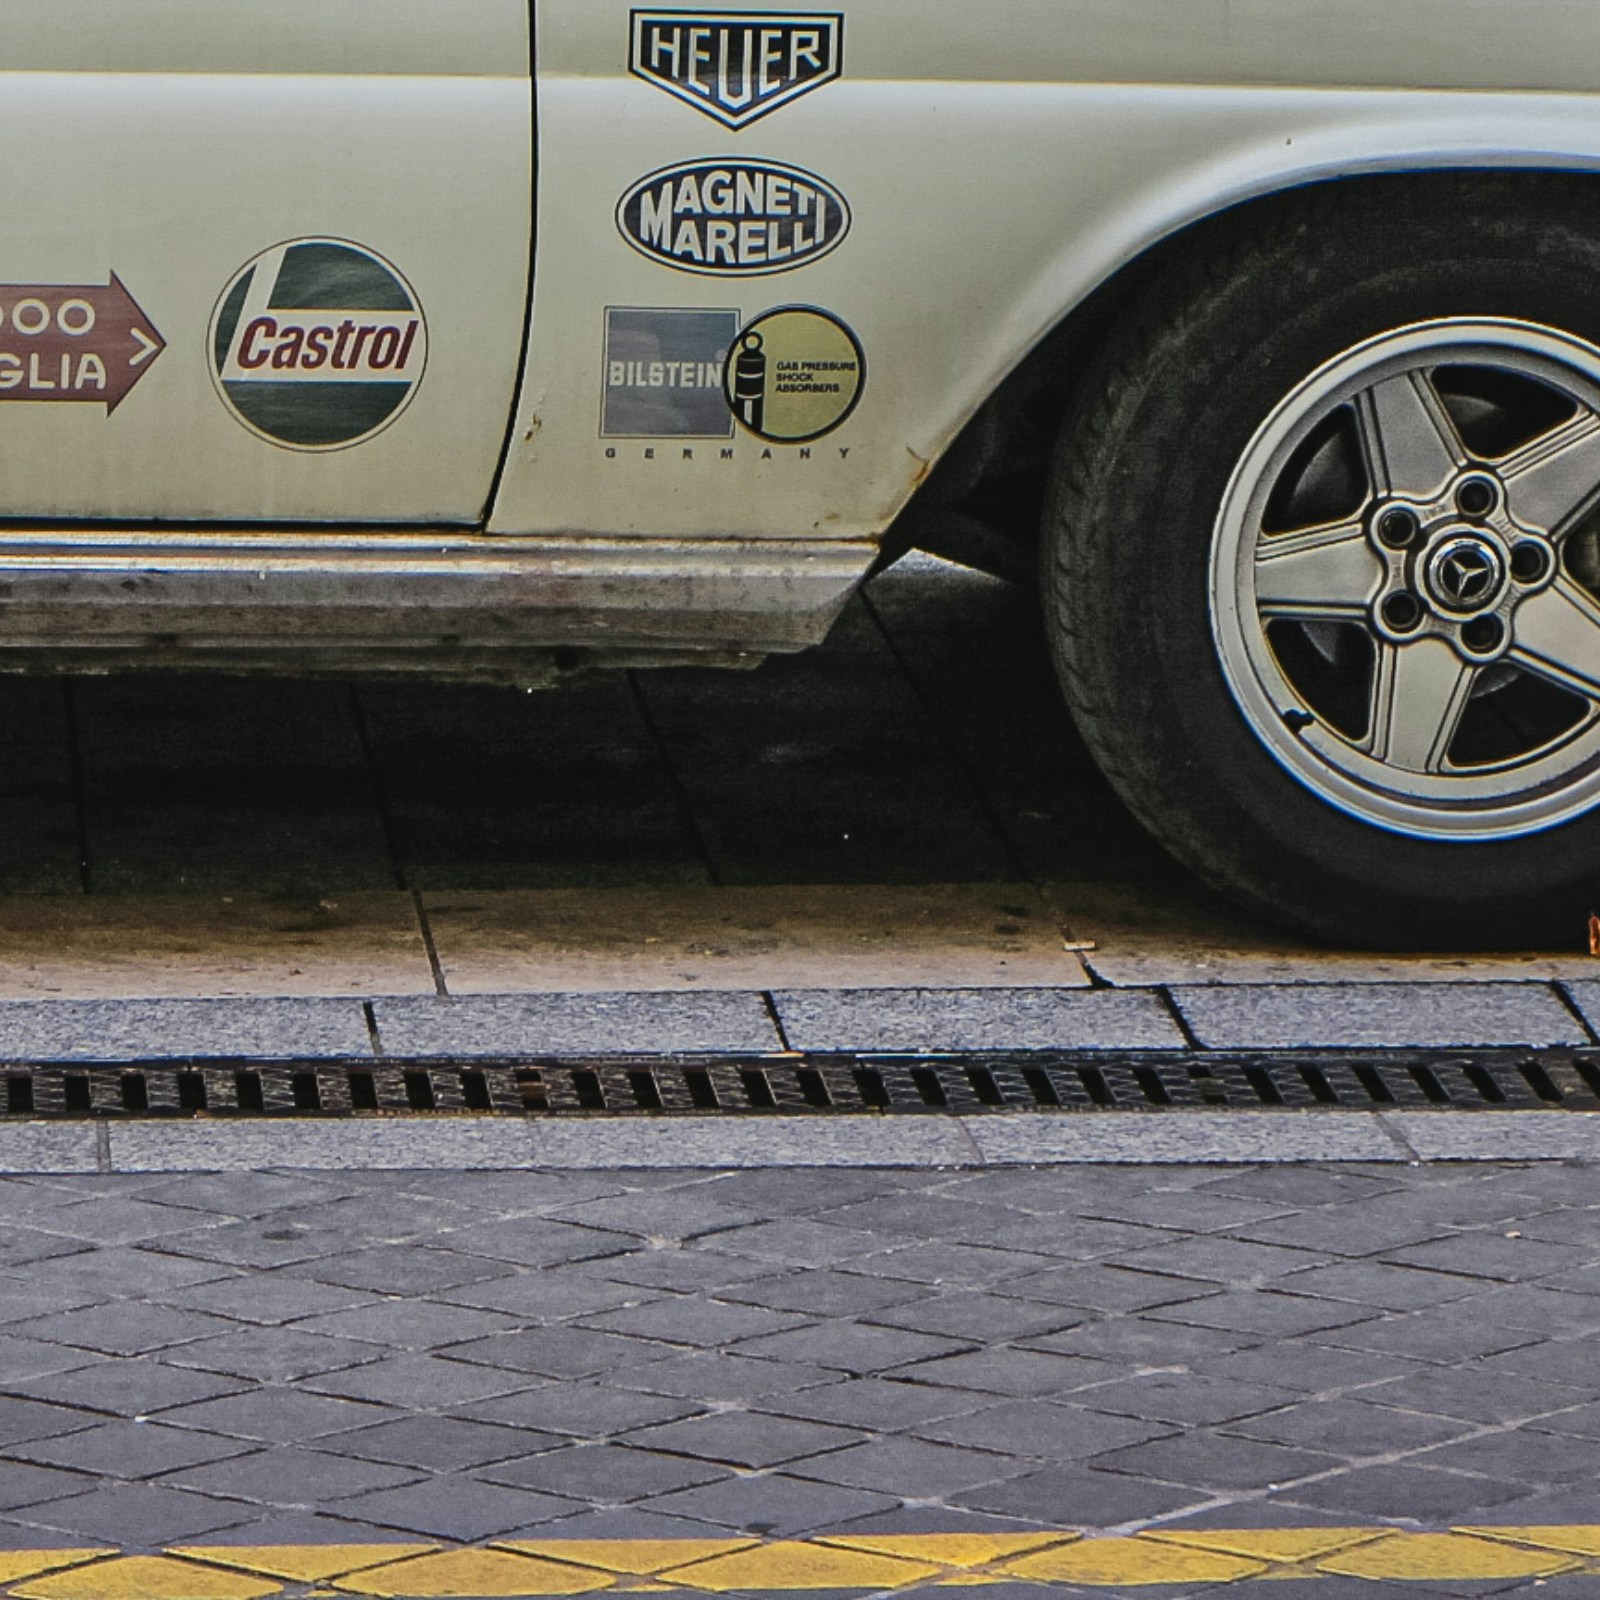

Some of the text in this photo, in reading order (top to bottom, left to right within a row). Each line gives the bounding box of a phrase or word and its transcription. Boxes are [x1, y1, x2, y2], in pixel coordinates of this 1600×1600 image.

[650, 26, 822, 110] HEUER
[639, 169, 826, 252] MAGNETI
[639, 180, 826, 264] MARELLI
[236, 316, 419, 370] Castrol
[608, 360, 723, 388] BILSTEIN
[776, 372, 814, 382] SHOCK
[777, 361, 856, 372] GAS PRESSURE
[775, 383, 840, 393] ABSORBERS
